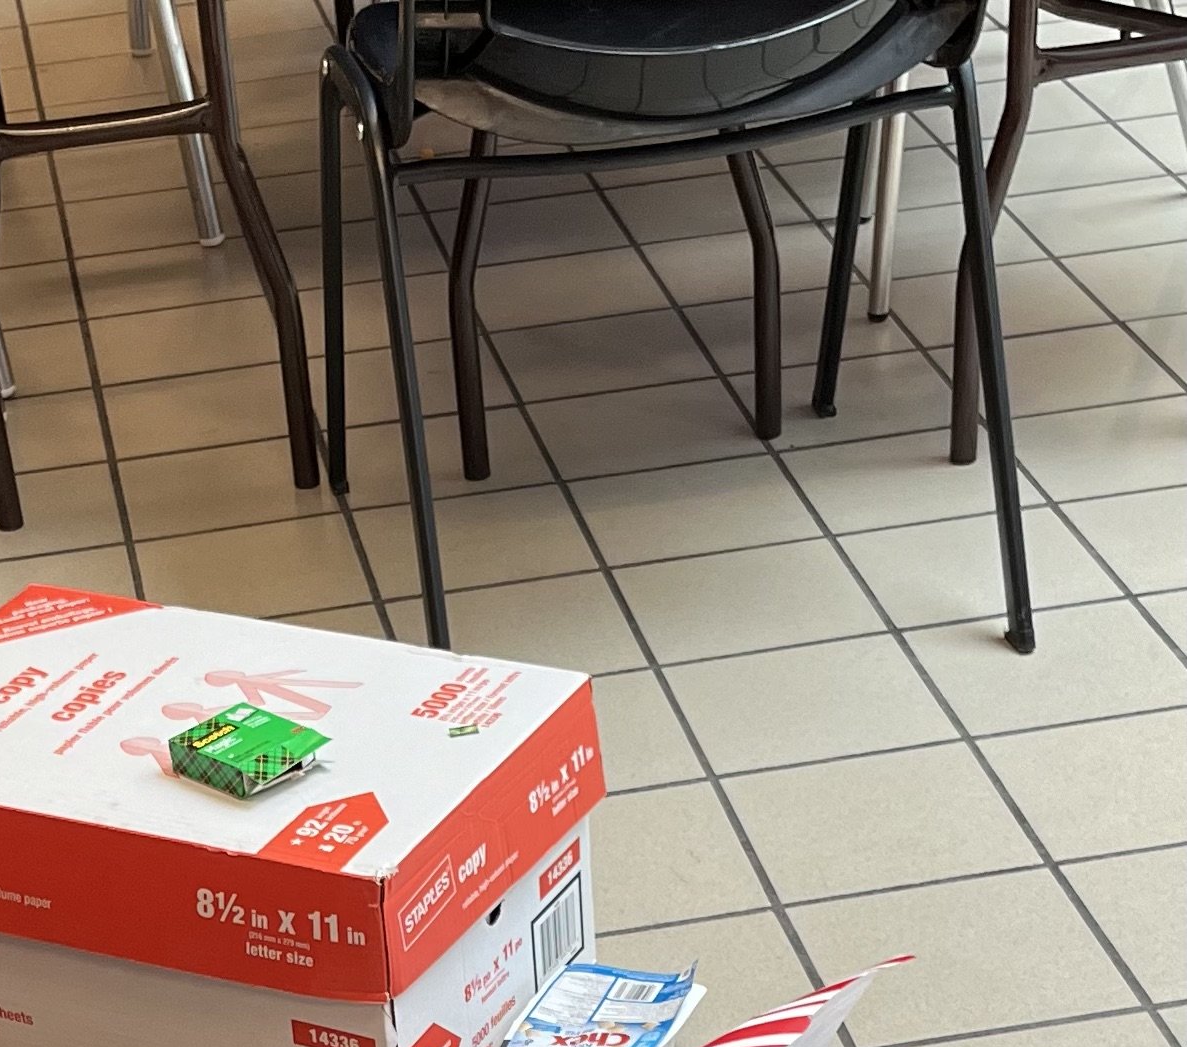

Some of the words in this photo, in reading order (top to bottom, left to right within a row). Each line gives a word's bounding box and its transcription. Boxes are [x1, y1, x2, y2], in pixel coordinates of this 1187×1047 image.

[52, 671, 127, 722] copies
[410, 683, 467, 718] 5000
[193, 724, 236, 748] Scotch
[571, 745, 585, 772] 11
[296, 819, 329, 837] 92
[323, 824, 354, 843] 20
[458, 843, 486, 883] copy
[548, 850, 573, 886] 14336
[24, 895, 52, 909] paper
[404, 871, 450, 933] STAPLES
[251, 909, 268, 929] in
[308, 911, 339, 942] 11
[347, 927, 365, 946] in
[246, 942, 282, 961] letter
[286, 952, 314, 967] size
[503, 939, 515, 962] 11
[490, 995, 516, 1028] feuilles
[550, 1033, 630, 1046] Chex
